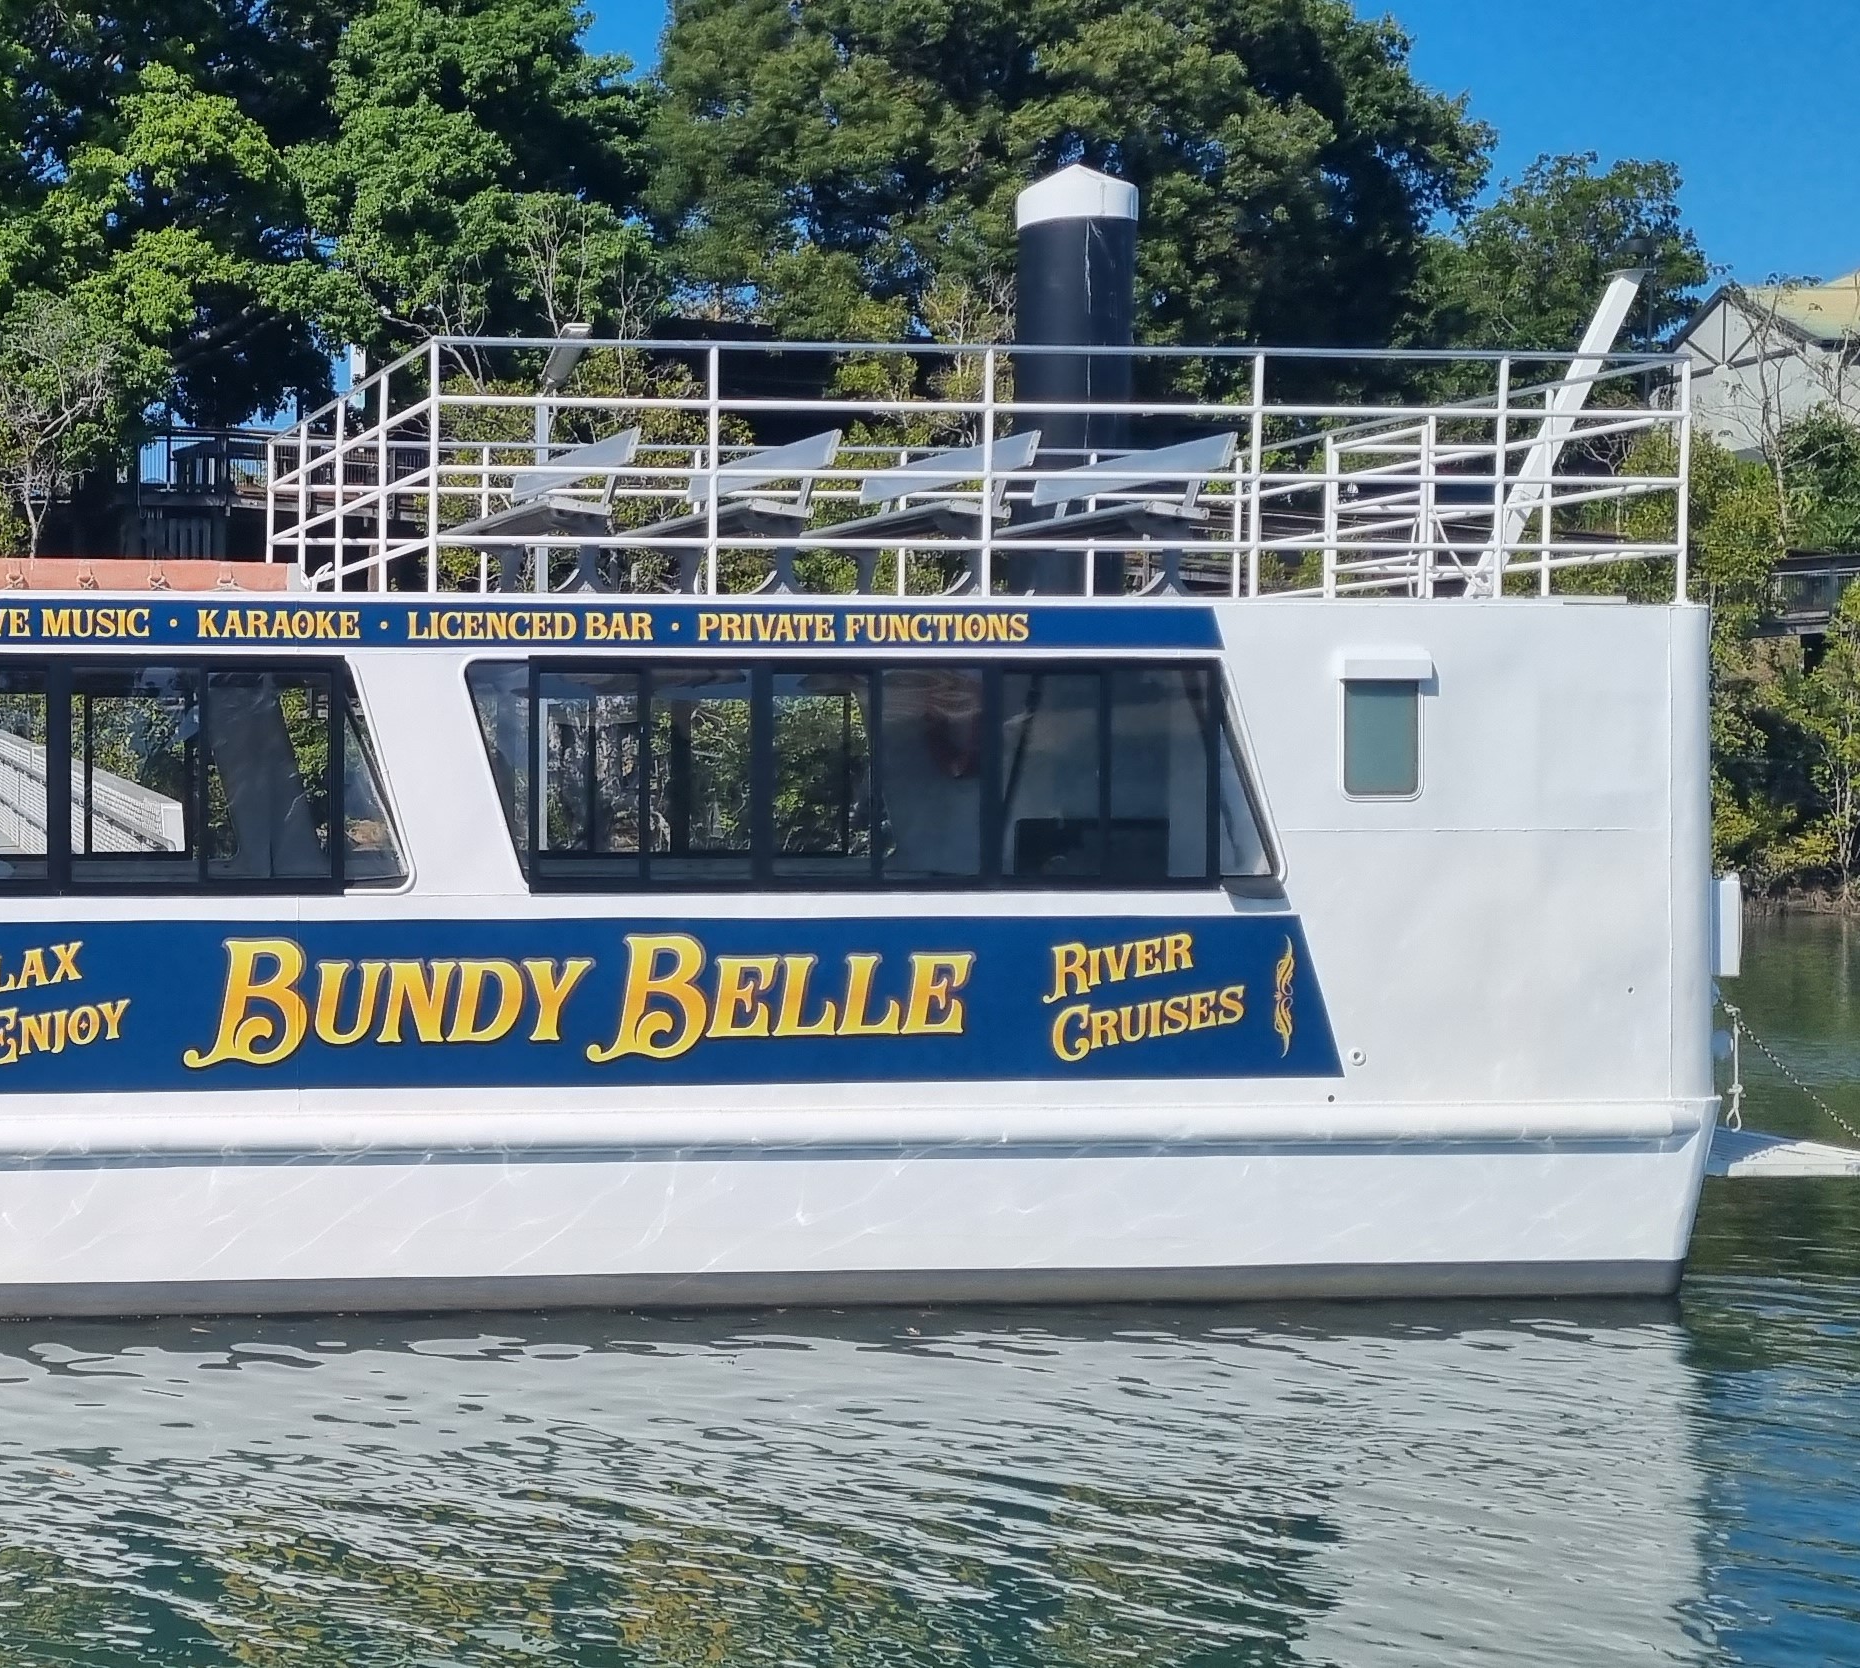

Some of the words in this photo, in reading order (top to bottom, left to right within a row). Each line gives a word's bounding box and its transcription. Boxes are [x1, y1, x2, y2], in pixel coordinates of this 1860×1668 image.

[41, 607, 151, 639] MUSIC
[197, 610, 360, 639] KARAOKE
[407, 611, 578, 641] LICENCED
[584, 612, 654, 642] BAR
[697, 613, 836, 642] PRIVATE
[845, 614, 1030, 642] FUNCTIONS
[182, 936, 591, 1070] BUNDY
[586, 933, 977, 1065] BELLE
[1042, 931, 1194, 1003] RIVER
[1050, 986, 1246, 1063] CRUISES
